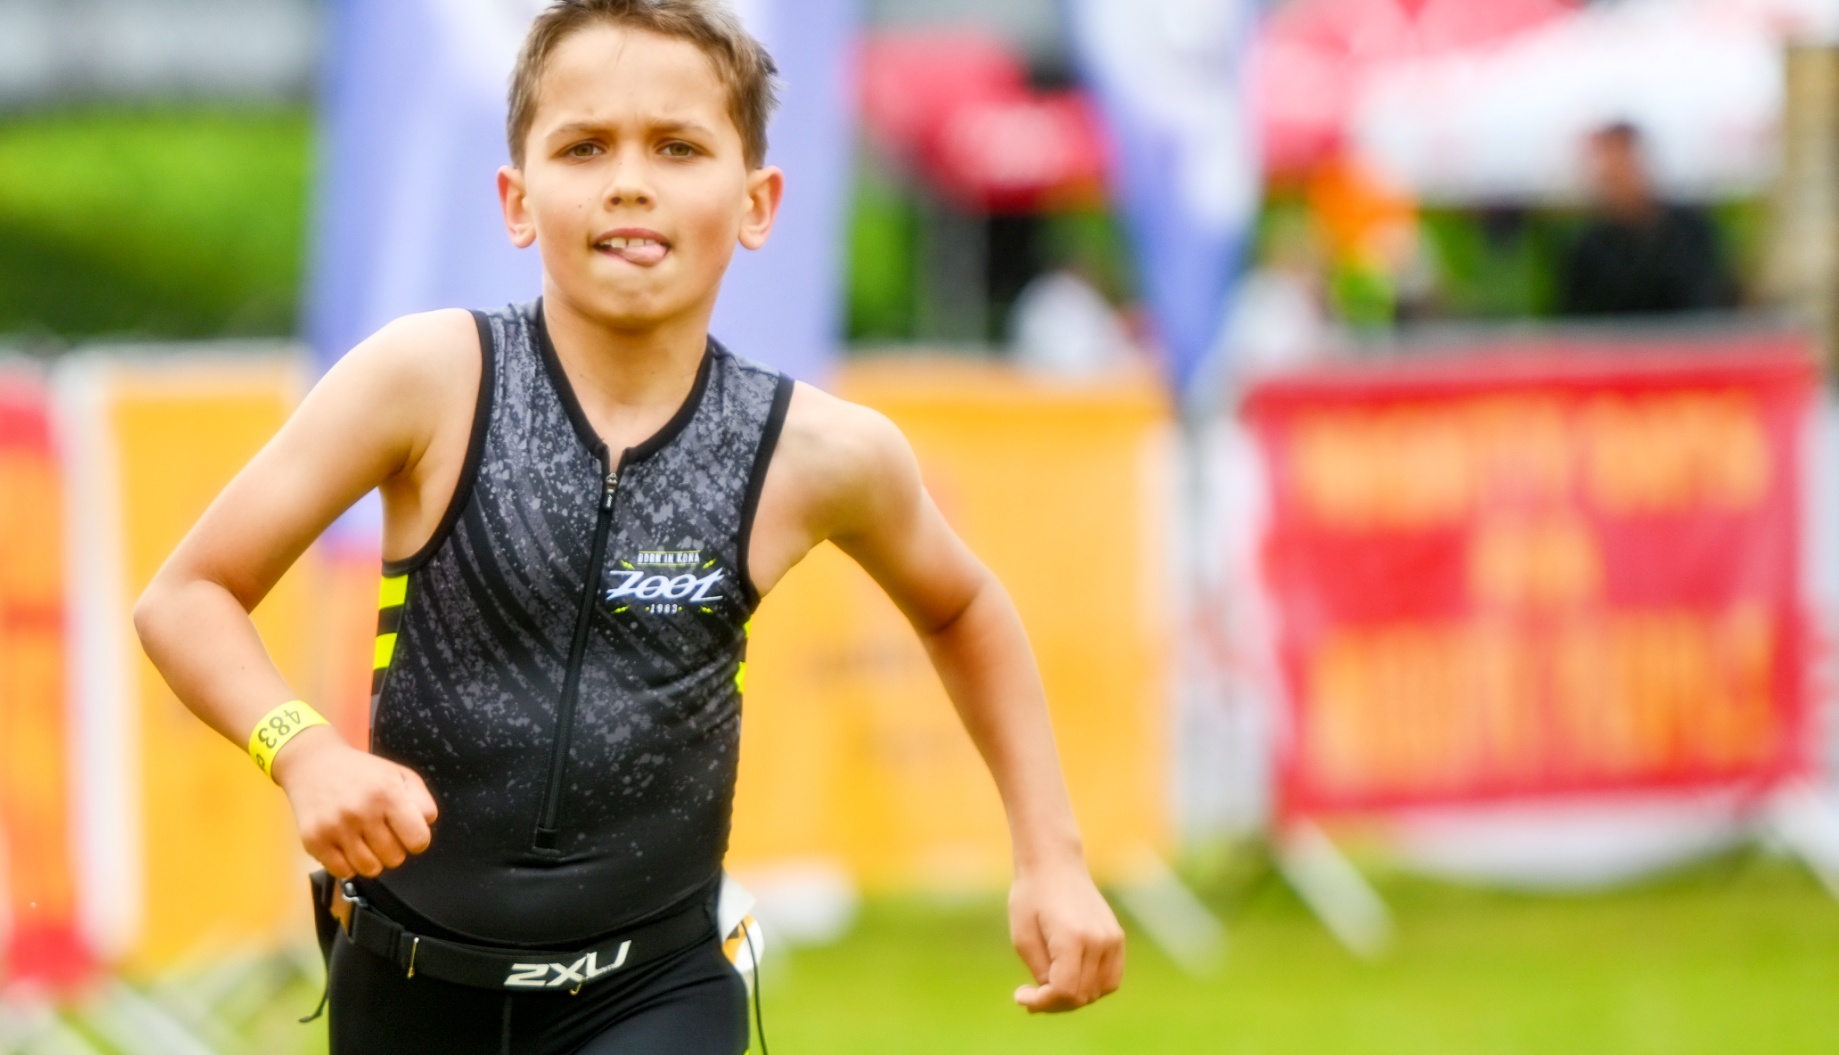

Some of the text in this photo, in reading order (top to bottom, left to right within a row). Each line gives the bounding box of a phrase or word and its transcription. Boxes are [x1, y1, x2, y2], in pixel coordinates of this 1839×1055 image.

[638, 552, 700, 563] BORN IN KONA
[257, 708, 302, 750] 483
[503, 939, 632, 988] 2XU
